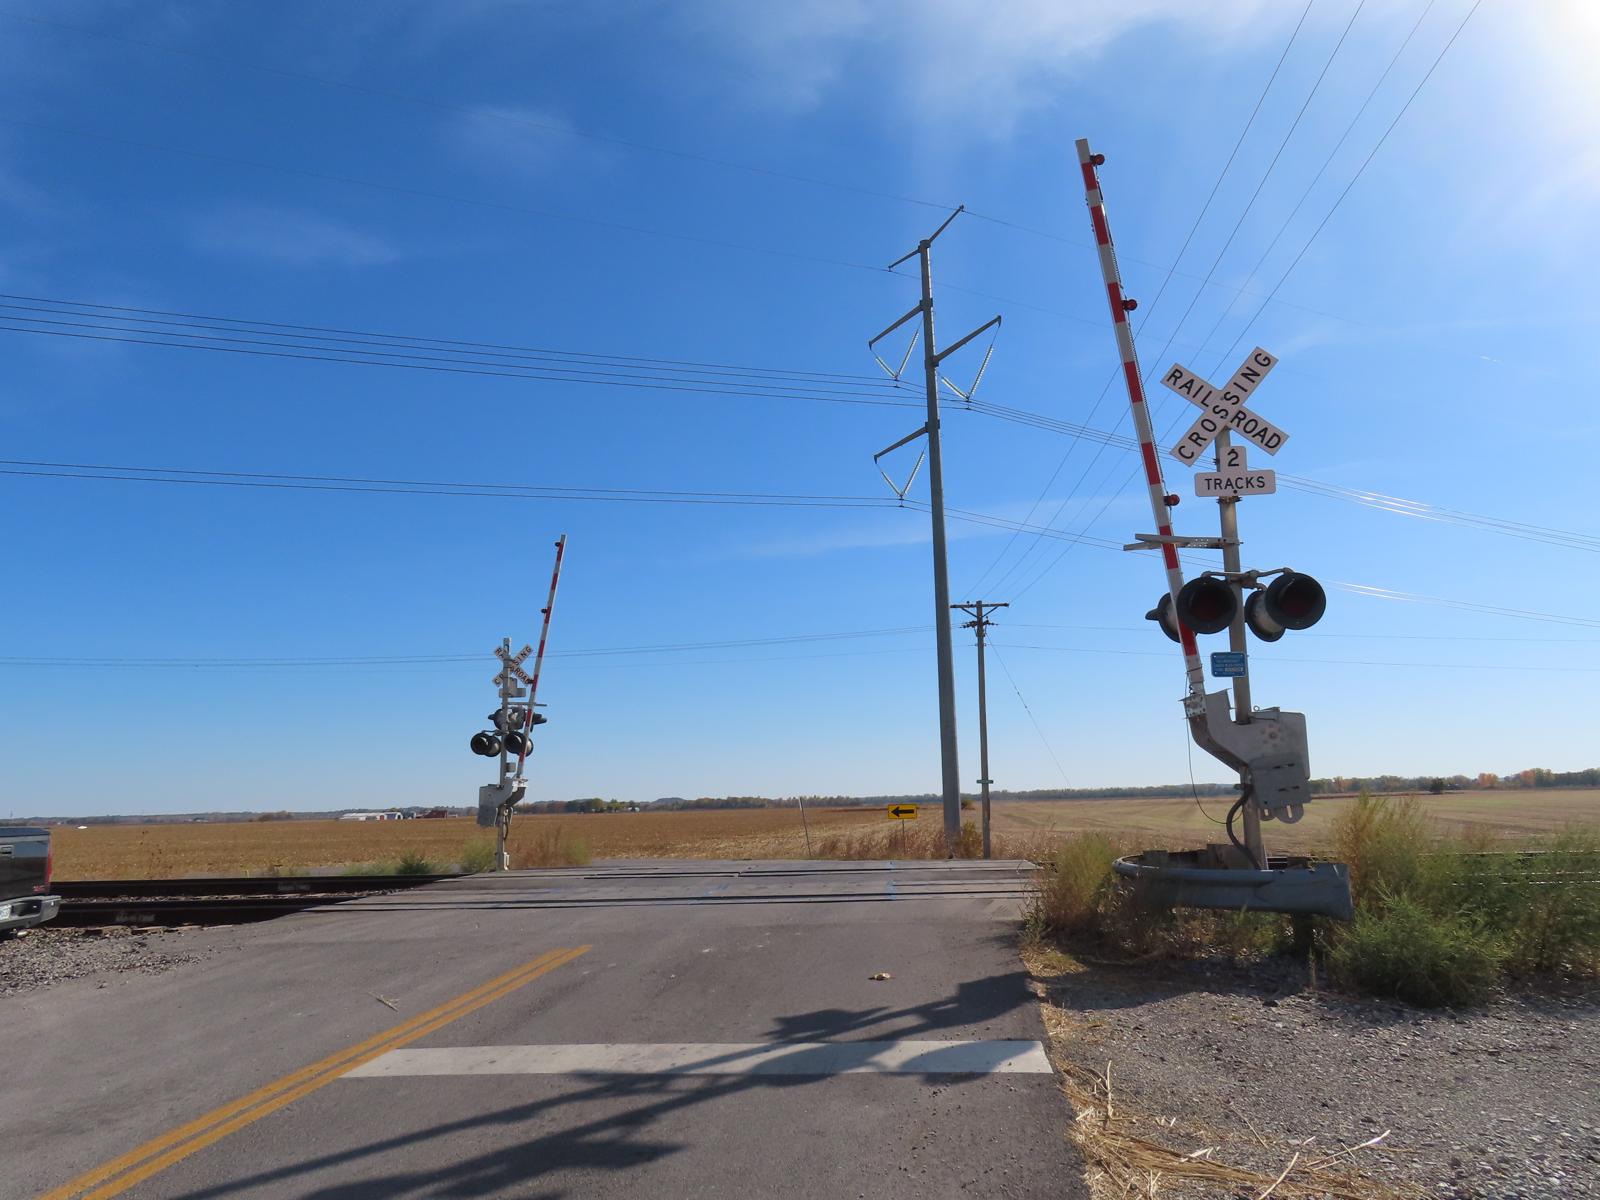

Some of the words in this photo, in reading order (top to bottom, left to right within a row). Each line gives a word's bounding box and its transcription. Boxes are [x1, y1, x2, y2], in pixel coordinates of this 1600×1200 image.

[1166, 368, 1213, 407] RAIL
[1230, 410, 1281, 449] ROAD
[1178, 352, 1272, 460] CROSSING
[1227, 448, 1240, 467] 2
[1204, 475, 1266, 491] TRACKS
